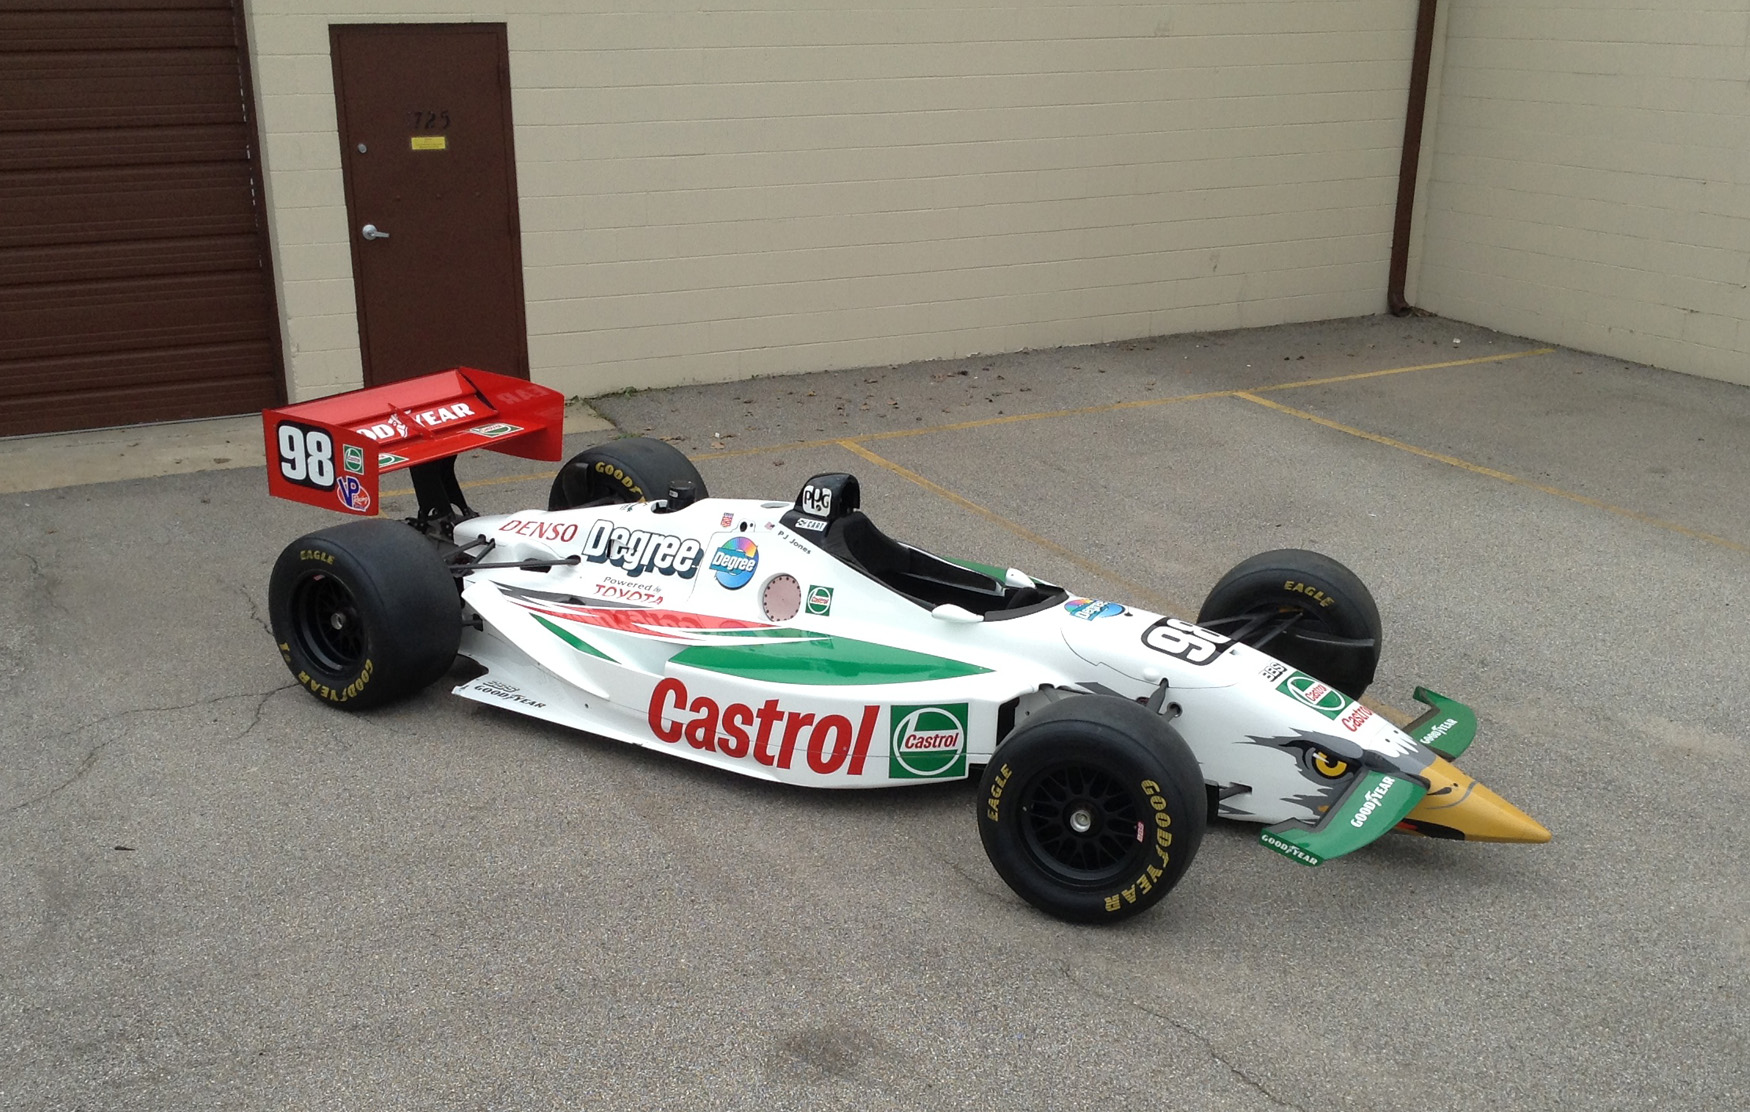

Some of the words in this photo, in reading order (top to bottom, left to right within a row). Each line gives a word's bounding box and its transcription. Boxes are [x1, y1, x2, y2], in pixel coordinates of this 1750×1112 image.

[278, 425, 335, 486] 98
[337, 476, 360, 508] VP
[499, 519, 579, 543] DENSO
[300, 550, 336, 566] EAGLE
[581, 519, 706, 580] Degree
[789, 538, 812, 555] Jones
[712, 551, 756, 572] Degree
[594, 583, 664, 605] TOYOTA
[603, 576, 653, 592] Powered
[1283, 580, 1335, 608] EAGLE
[299, 658, 374, 702] GOODYEAR
[474, 685, 547, 709] GOODYEAR
[648, 677, 880, 775] Castrol
[1419, 718, 1458, 744] GOODYEAR
[904, 732, 960, 750] Castrol
[987, 763, 1013, 822] EAGLE
[1350, 775, 1396, 828] GOODYEAR
[1104, 779, 1172, 912] GOODYEAR
[1261, 834, 1319, 866] GOODYEAR
